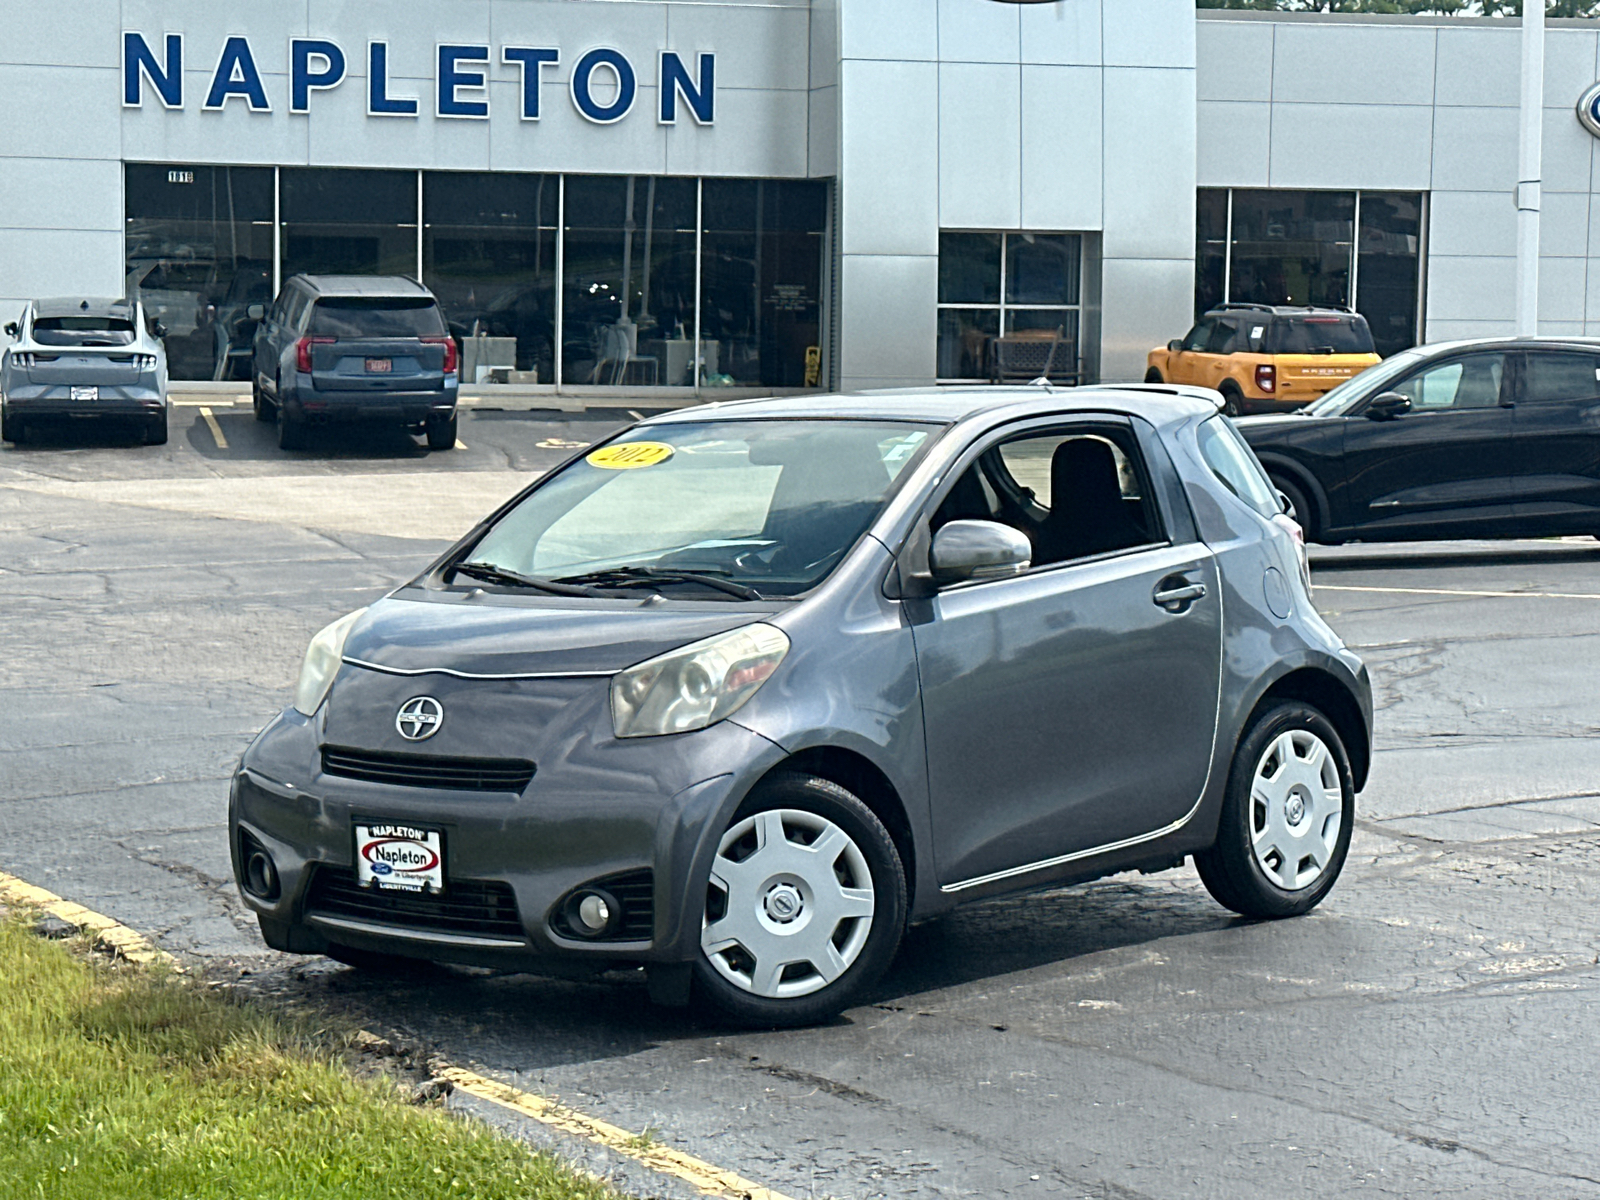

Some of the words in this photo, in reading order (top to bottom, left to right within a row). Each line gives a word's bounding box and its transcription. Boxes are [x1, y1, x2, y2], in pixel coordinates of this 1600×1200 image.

[121, 31, 716, 125] NAPLETON
[597, 446, 665, 462] 2012
[372, 825, 422, 839] NAPLETON
[375, 846, 427, 865] Napleton
